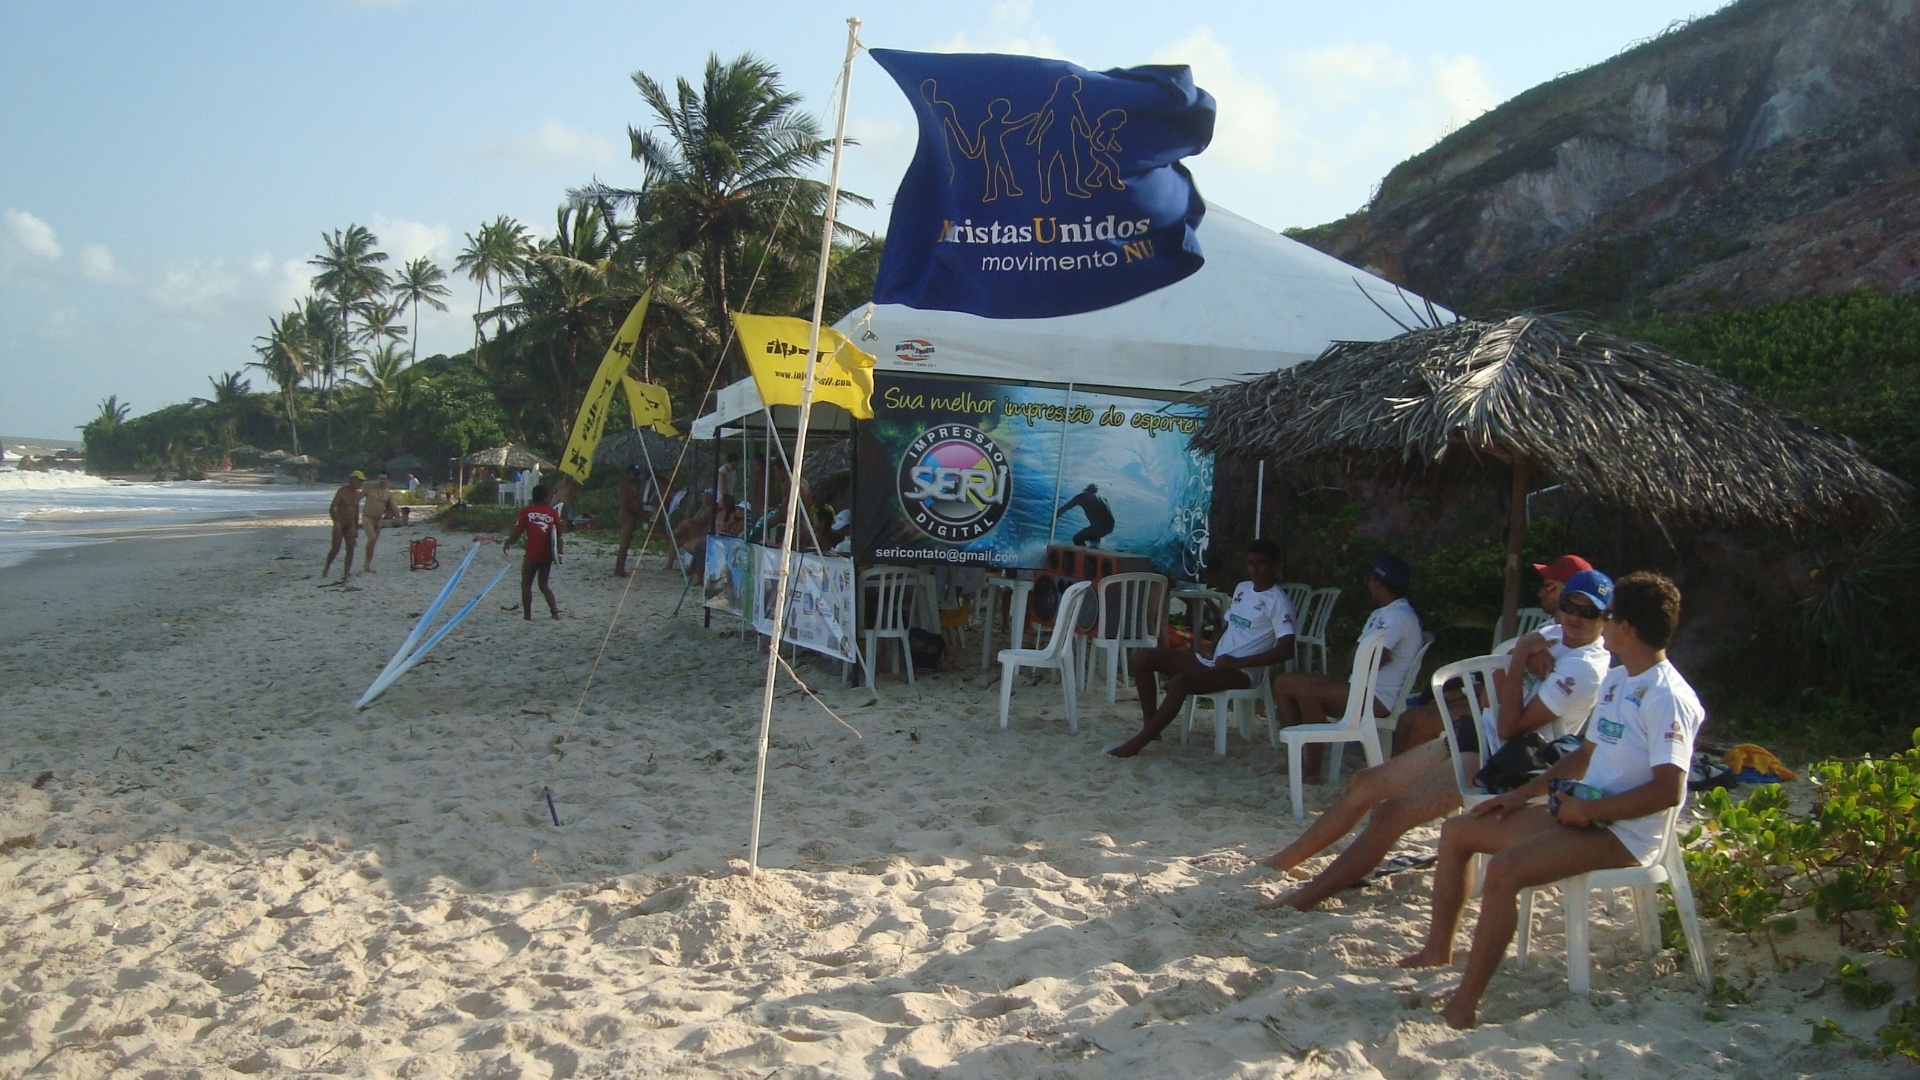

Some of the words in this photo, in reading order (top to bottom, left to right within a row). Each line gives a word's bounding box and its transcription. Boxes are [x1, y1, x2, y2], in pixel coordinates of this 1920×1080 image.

[981, 251, 1118, 271] movimento
[884, 386, 925, 409] Sua
[931, 392, 996, 413] melhor
[1100, 405, 1125, 426] do
[916, 512, 994, 538] DIGITAL
[875, 547, 1019, 563] sericontato@gmail.com
